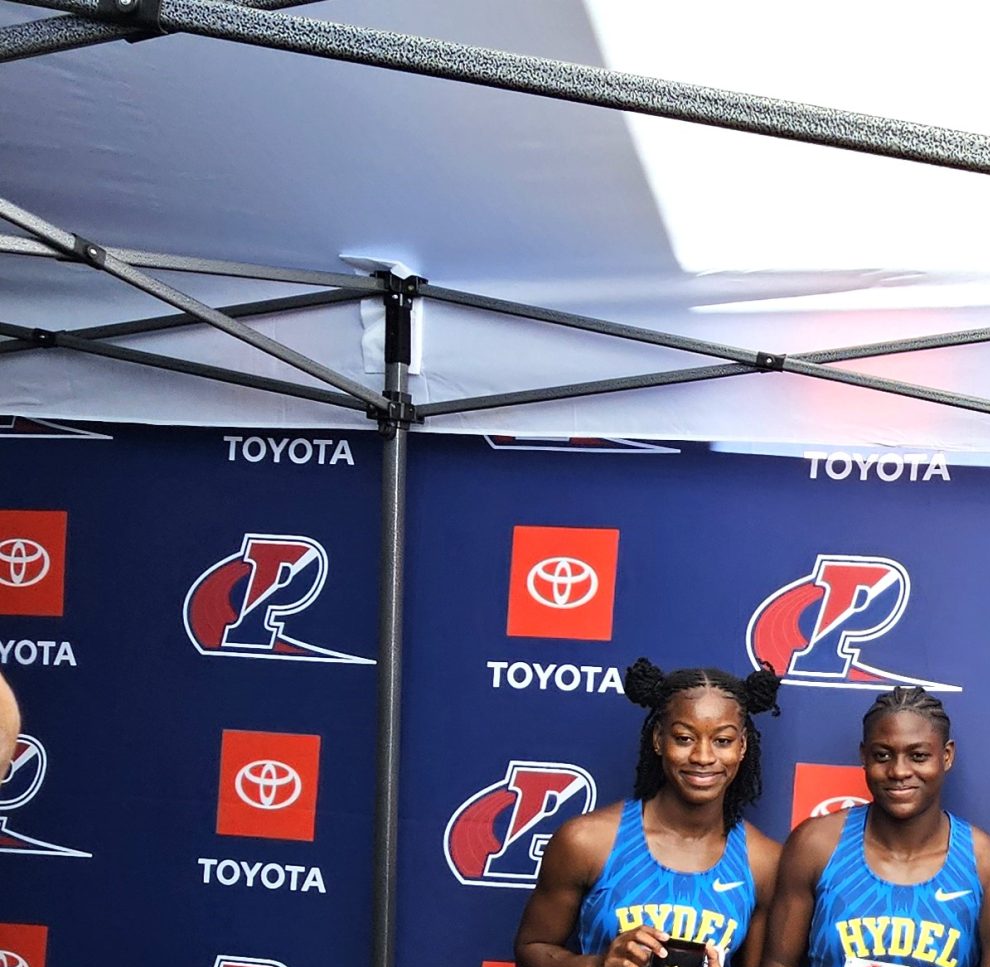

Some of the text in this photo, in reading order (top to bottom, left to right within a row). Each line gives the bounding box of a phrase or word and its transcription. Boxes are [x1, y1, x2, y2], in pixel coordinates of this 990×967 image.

[224, 436, 354, 465] TOYOTA
[803, 451, 950, 482] TOYOTA
[487, 661, 625, 694] TOYOTA
[198, 858, 326, 893] TOYOTA
